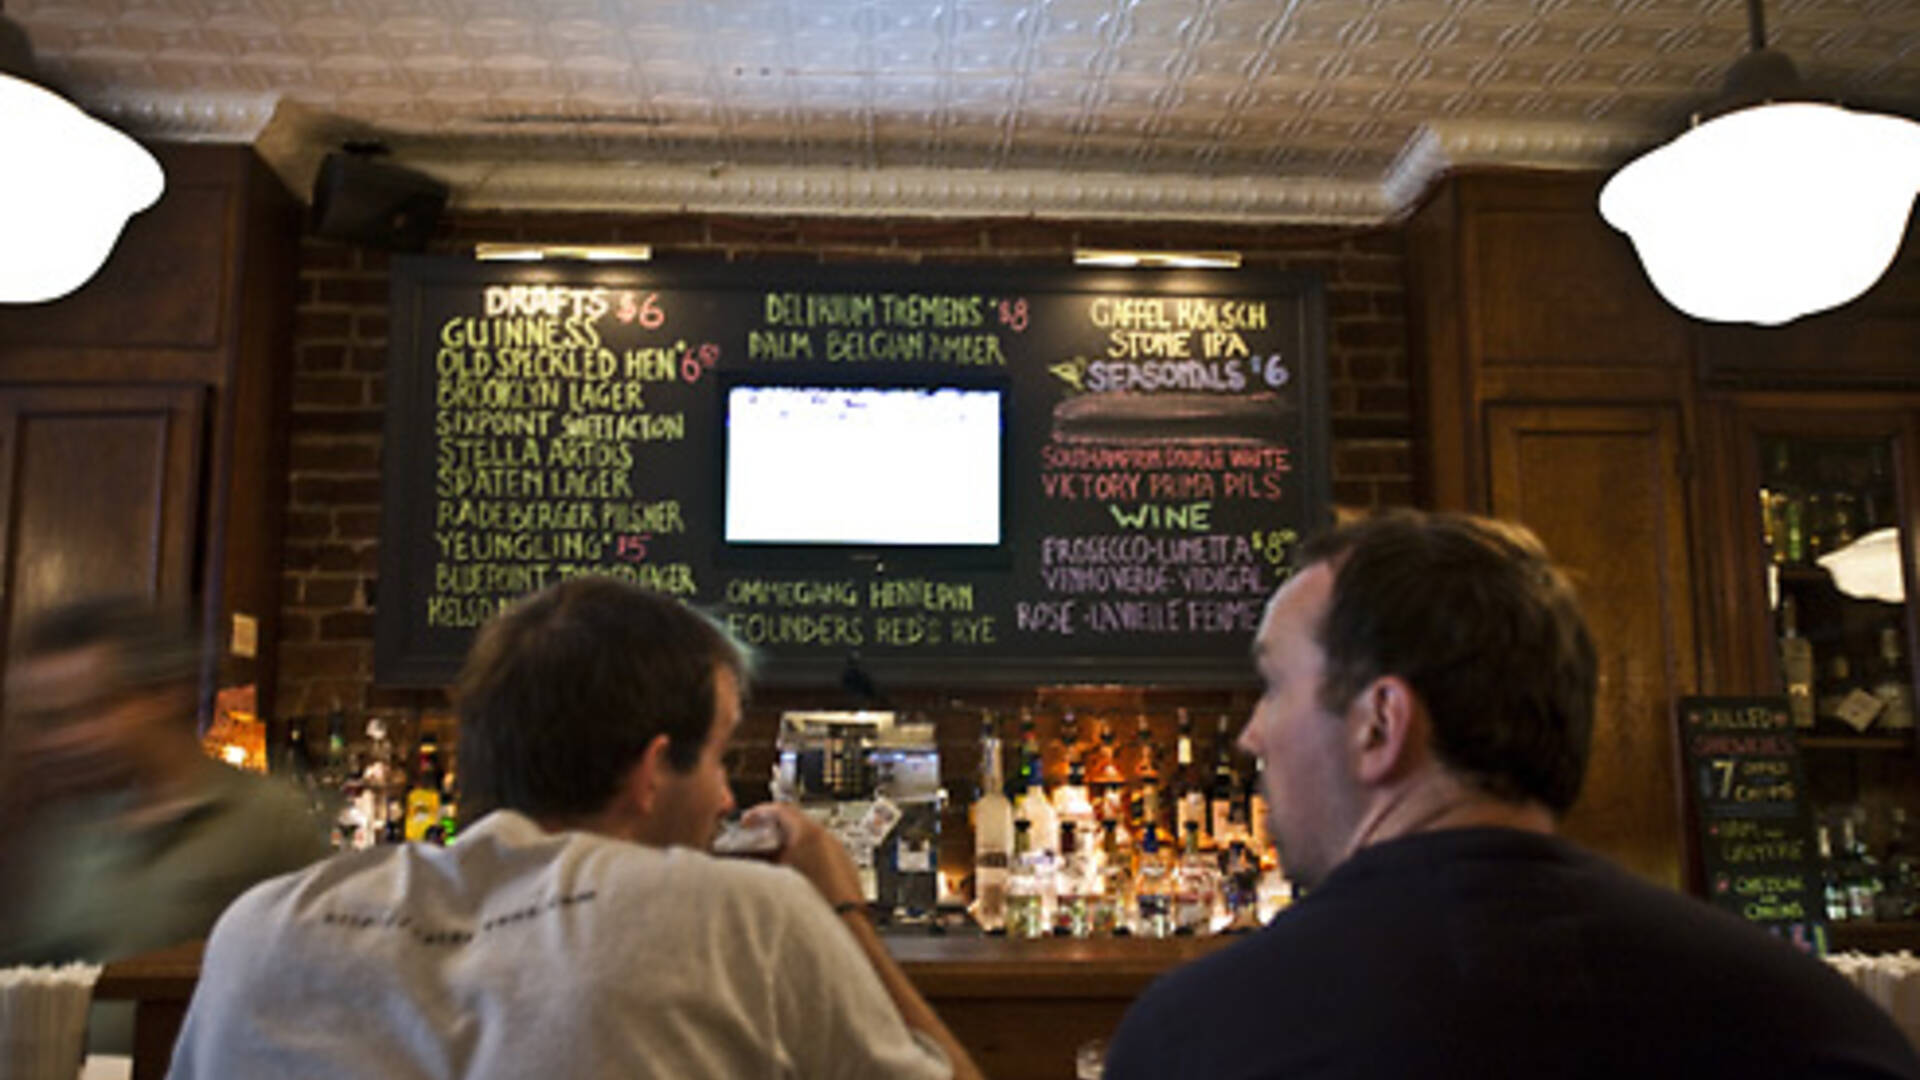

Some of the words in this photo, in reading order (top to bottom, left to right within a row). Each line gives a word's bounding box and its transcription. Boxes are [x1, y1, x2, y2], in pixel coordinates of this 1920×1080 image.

[485, 286, 609, 318] DRAFTS
[616, 290, 664, 329] $6
[1091, 298, 1171, 329] GAFFEL
[441, 316, 599, 349] GUINNESS
[749, 331, 812, 360] PALM
[1107, 330, 1191, 358] STONE
[1203, 331, 1249, 358] IPA
[437, 347, 492, 378] OLD
[498, 348, 617, 380] SPECKLED
[436, 379, 560, 409] BROOKLYN
[568, 381, 645, 413] LAGER
[435, 410, 554, 438] SIXPOINT
[438, 438, 540, 467] STELLA
[436, 469, 543, 498] SPATEN
[552, 470, 633, 499] LAGER
[1041, 473, 1141, 499] VICTORY
[1223, 472, 1282, 500] PILS
[1109, 501, 1213, 531] WINE
